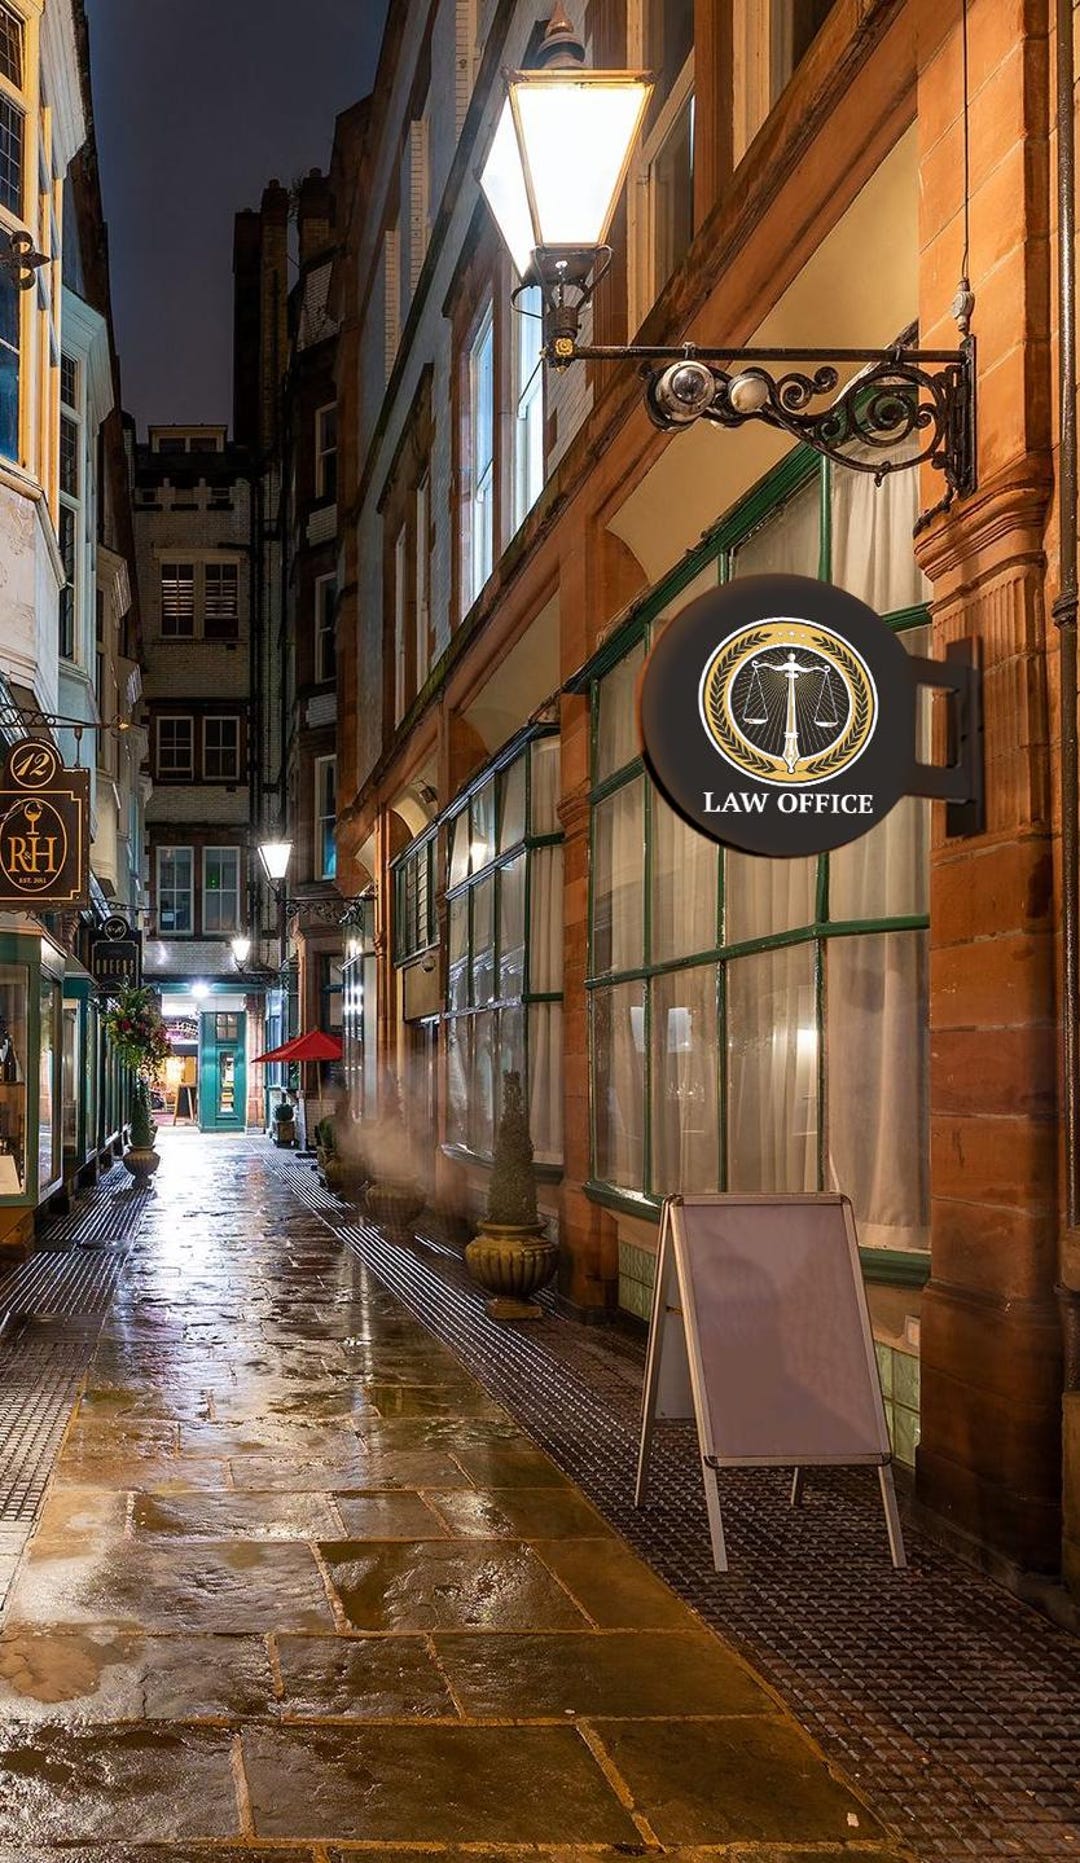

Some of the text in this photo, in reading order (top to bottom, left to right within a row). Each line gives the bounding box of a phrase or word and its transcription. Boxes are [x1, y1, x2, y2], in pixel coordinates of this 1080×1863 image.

[15, 753, 49, 776] 12
[703, 791, 874, 814] LAW OFFICE
[8, 836, 58, 872] R&H
